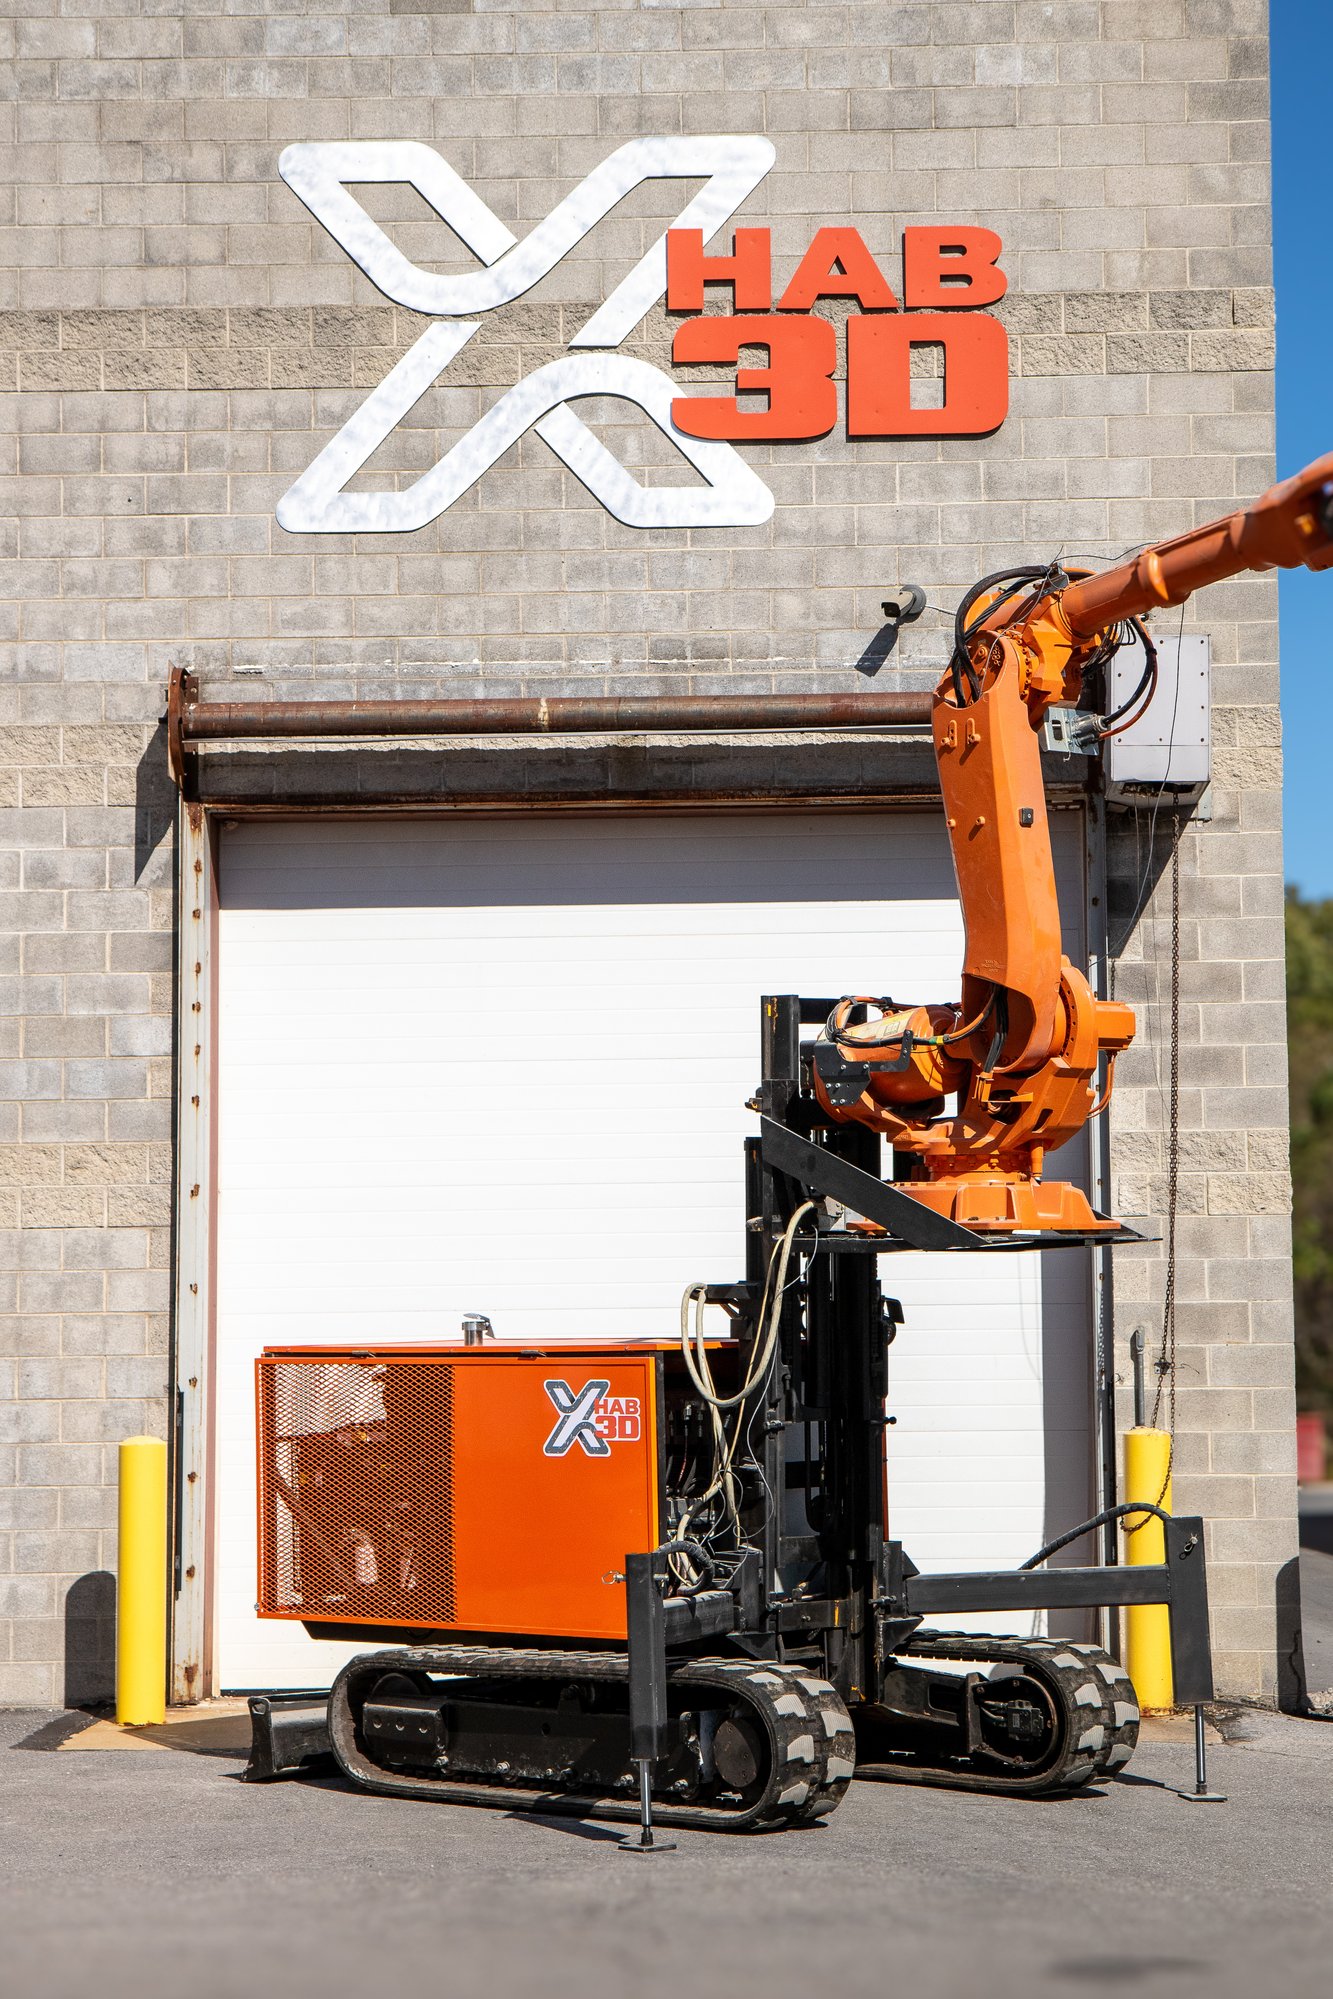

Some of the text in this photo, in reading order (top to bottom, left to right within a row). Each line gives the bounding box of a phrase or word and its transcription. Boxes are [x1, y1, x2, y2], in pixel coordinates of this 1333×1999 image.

[667, 226, 1008, 309] HAB
[672, 314, 1009, 439] 3D
[594, 1399, 639, 1414] HAB
[595, 1415, 639, 1438] 3D
